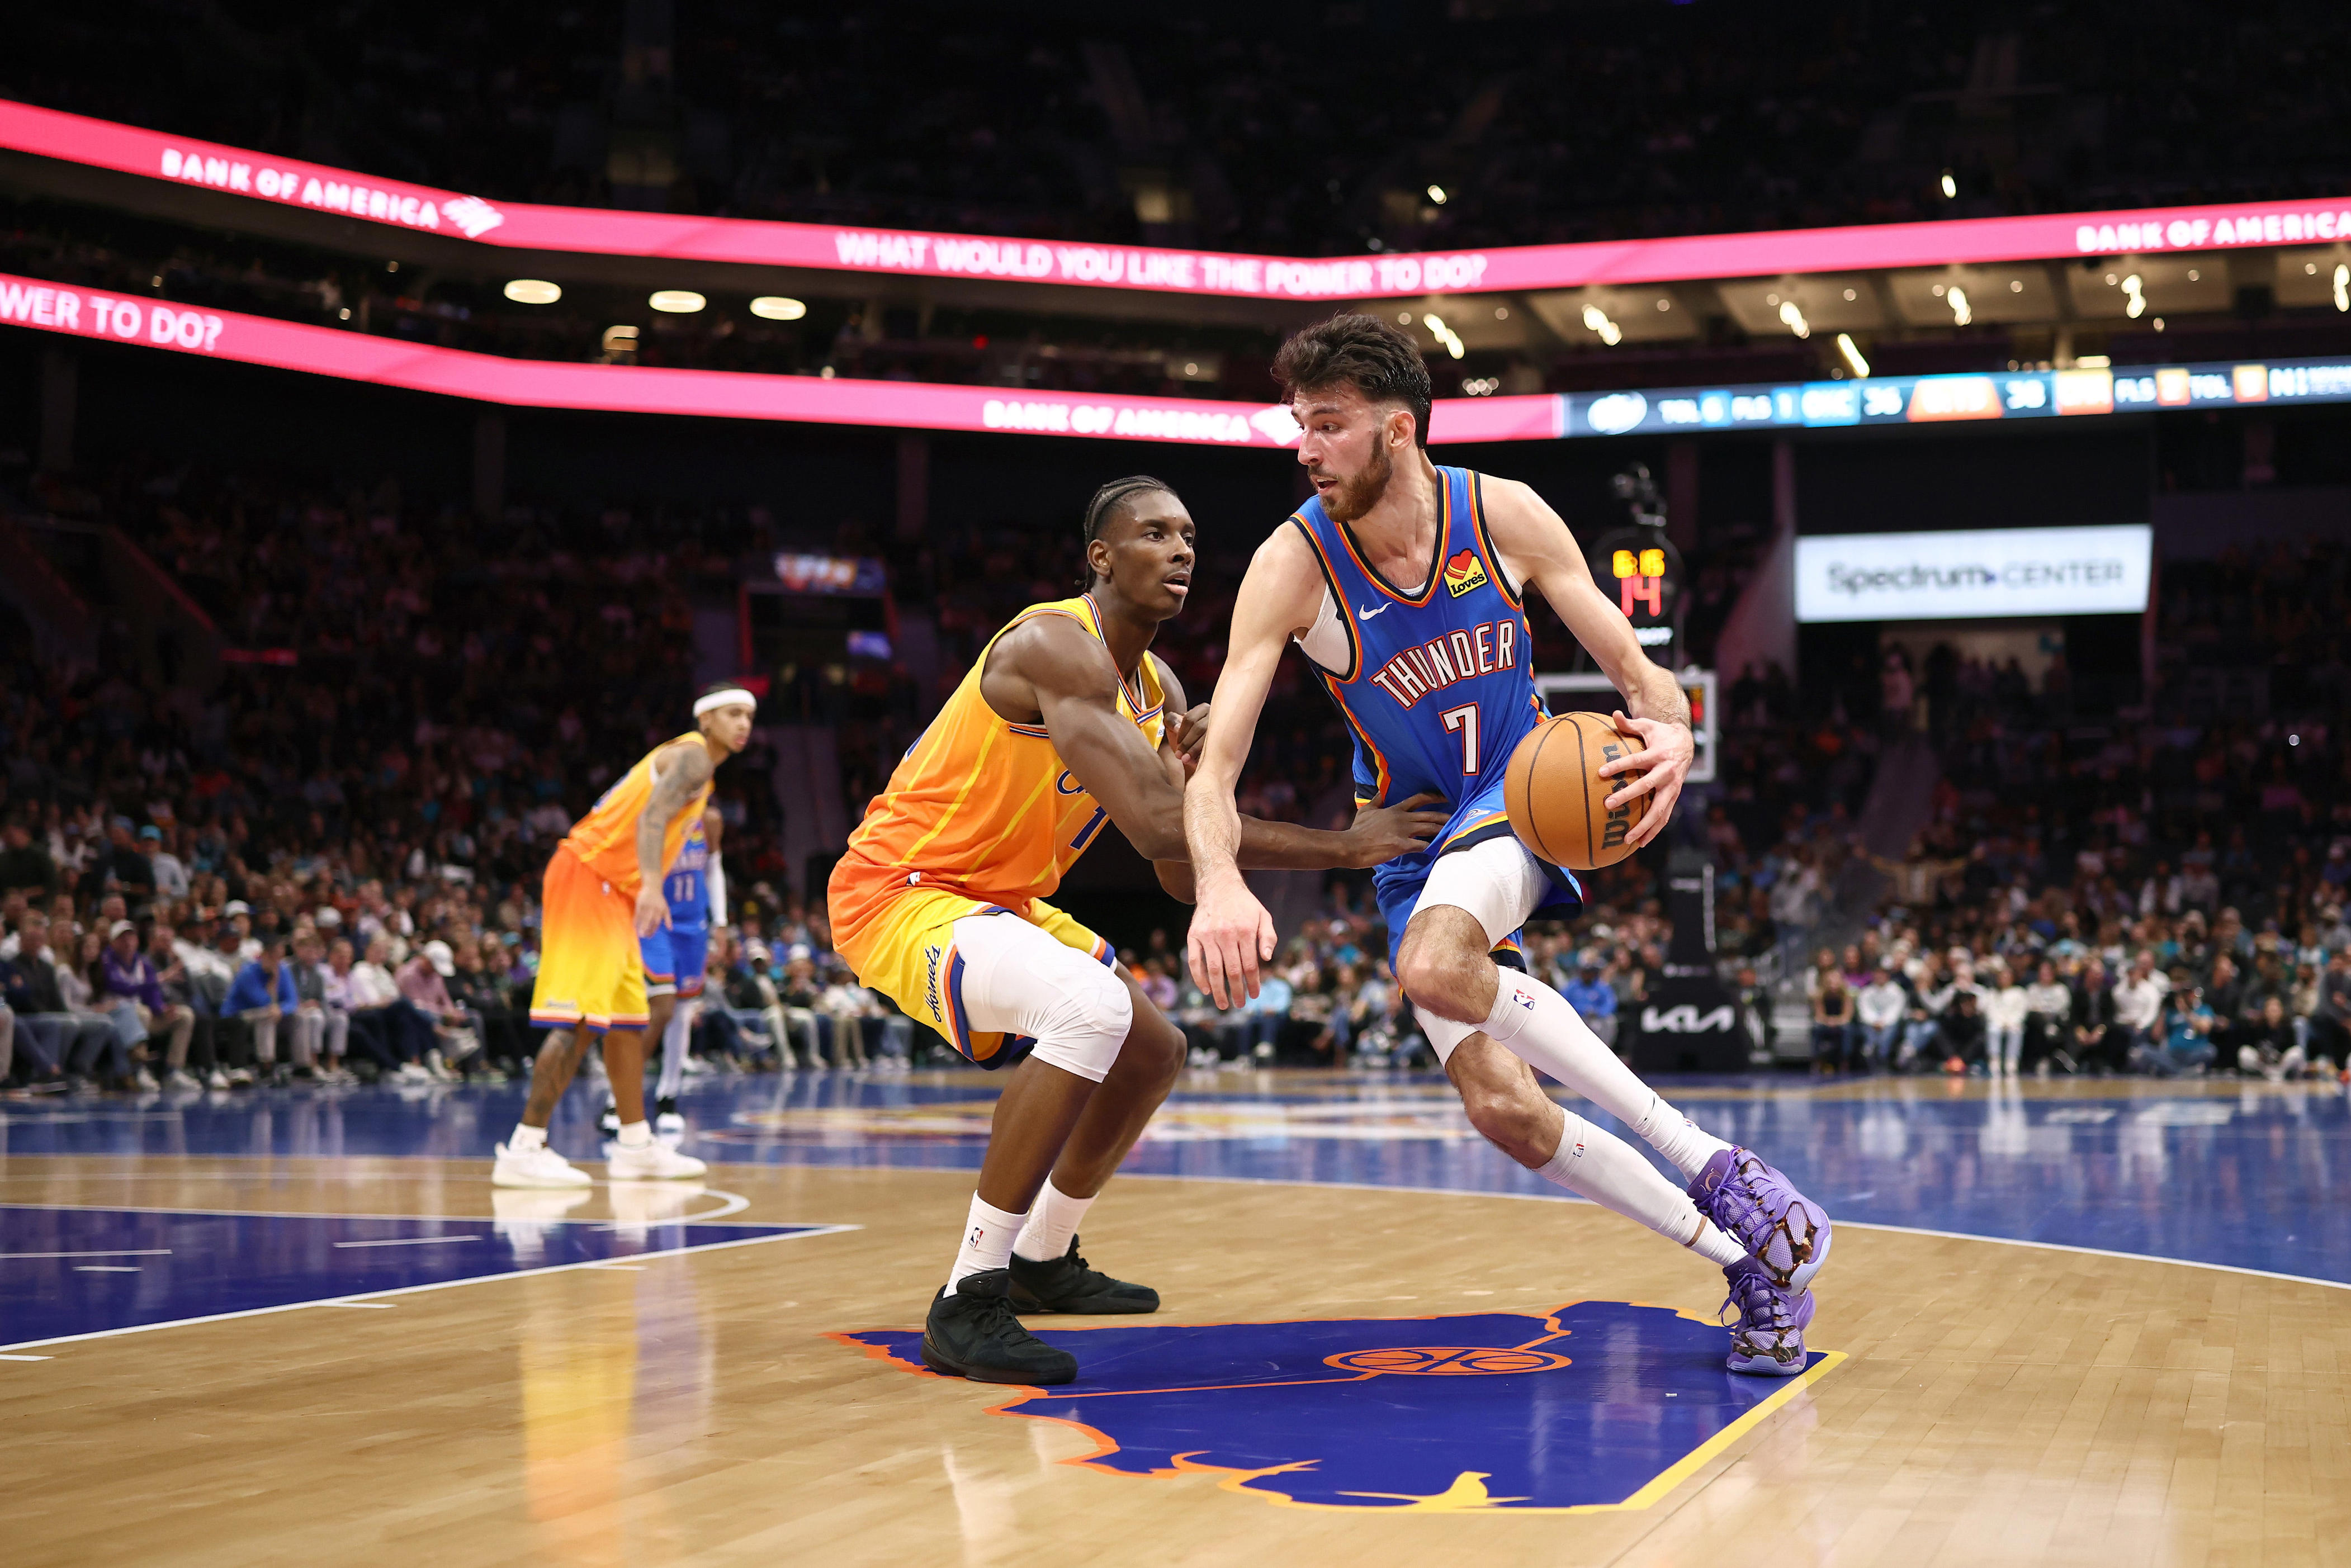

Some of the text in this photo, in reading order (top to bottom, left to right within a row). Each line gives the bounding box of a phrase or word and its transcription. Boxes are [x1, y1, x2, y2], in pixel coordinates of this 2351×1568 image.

[162, 149, 441, 229] BANK OF AMERICA
[835, 231, 1487, 296] WHAT WOULD YOU LIKE THE POWER TO DO?
[2076, 222, 2164, 253] BANK
[2166, 219, 2211, 247] OF
[89, 296, 141, 338] TO
[150, 306, 223, 352] DO?
[983, 400, 1251, 442] BANK OF AMERICA
[1621, 573, 1661, 617] 14
[1828, 559, 2123, 595] Spectrum CENTER
[1369, 619, 1516, 710] THUNDER
[1439, 702, 1480, 776] 7
[674, 873, 694, 902] 11
[924, 944, 942, 1023] Hornets
